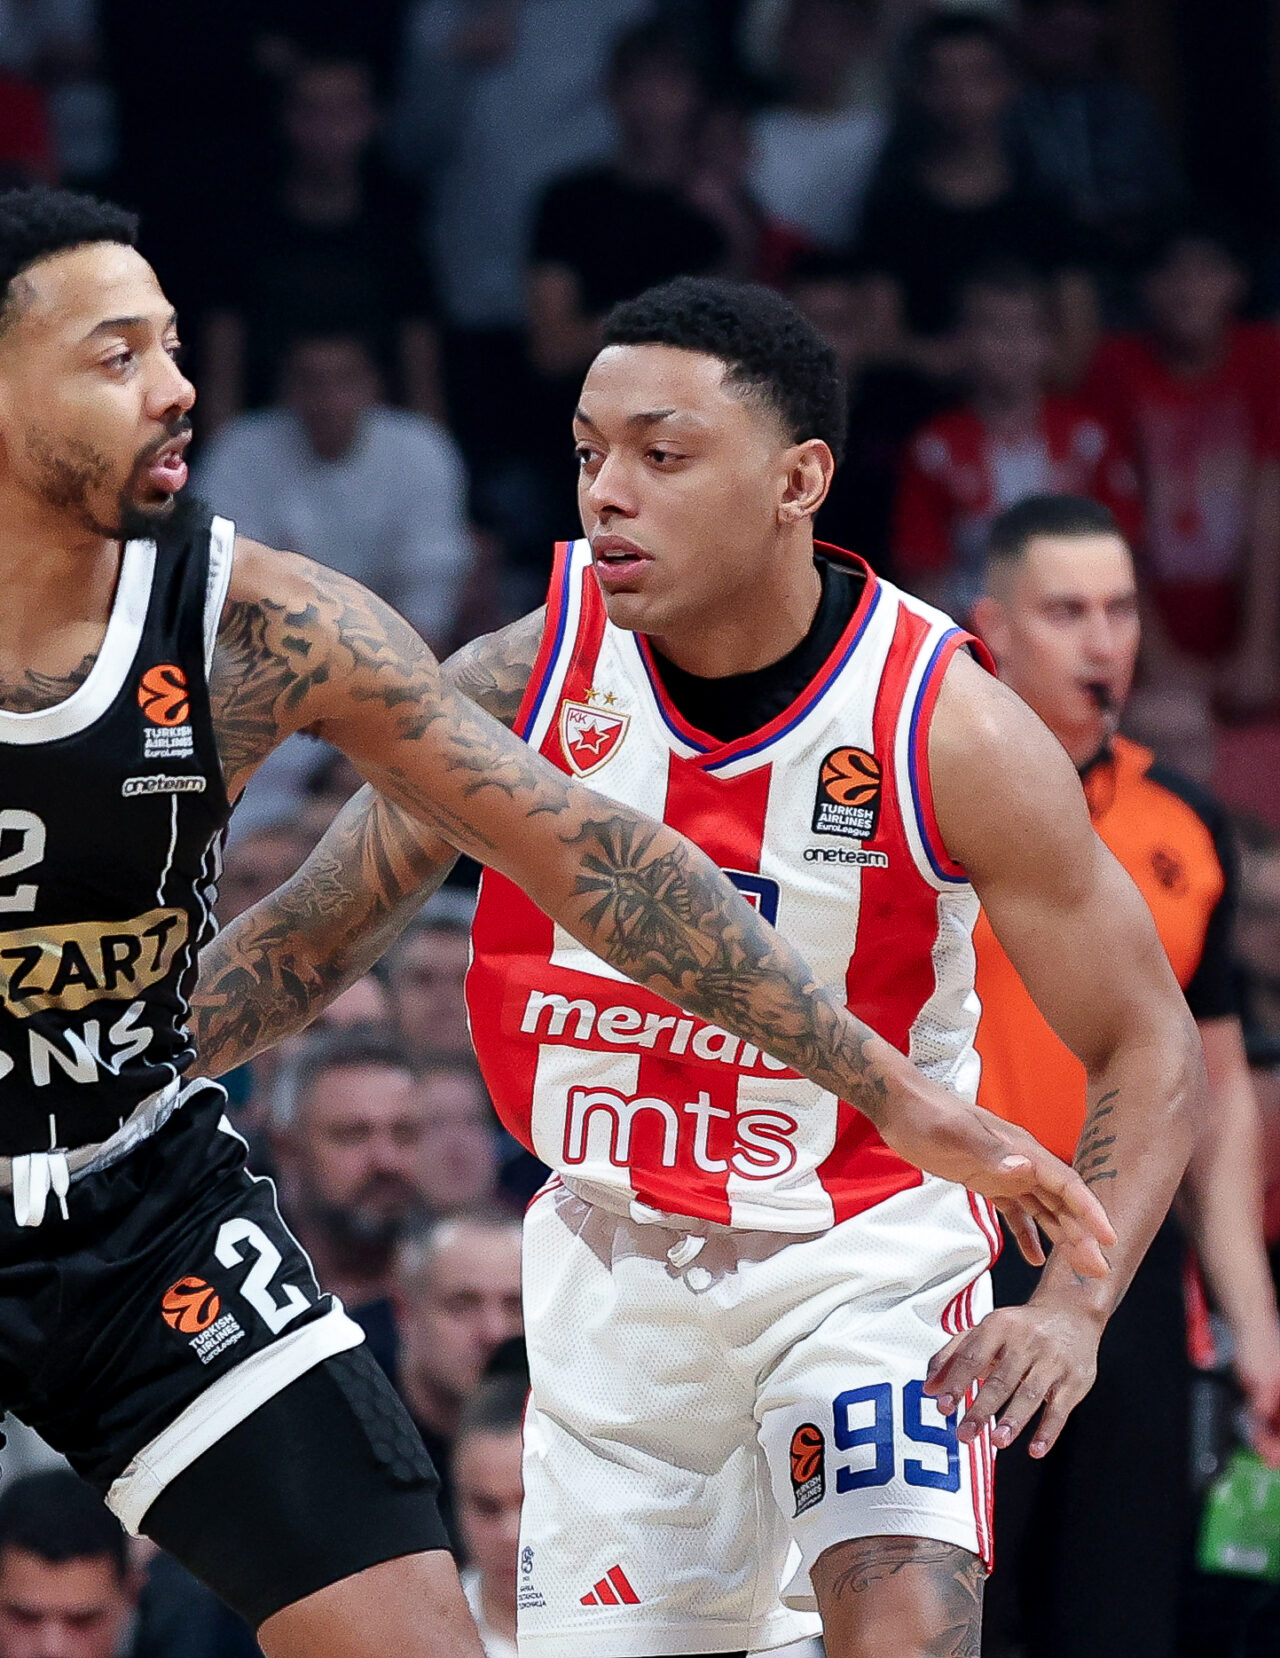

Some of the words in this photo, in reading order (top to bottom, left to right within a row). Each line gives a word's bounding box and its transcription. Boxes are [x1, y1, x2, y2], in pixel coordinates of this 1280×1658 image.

[123, 775, 205, 795] oneteam
[819, 813, 872, 829] AIRLINES
[820, 803, 873, 819] TURKISH
[816, 822, 870, 837] EuroLeague
[803, 847, 886, 866] oneteam
[563, 1088, 797, 1180] mts
[215, 1217, 311, 1335] 2
[188, 1313, 235, 1348] TURKISH
[196, 1322, 240, 1357] AIRLINES
[833, 1379, 961, 1494] 99
